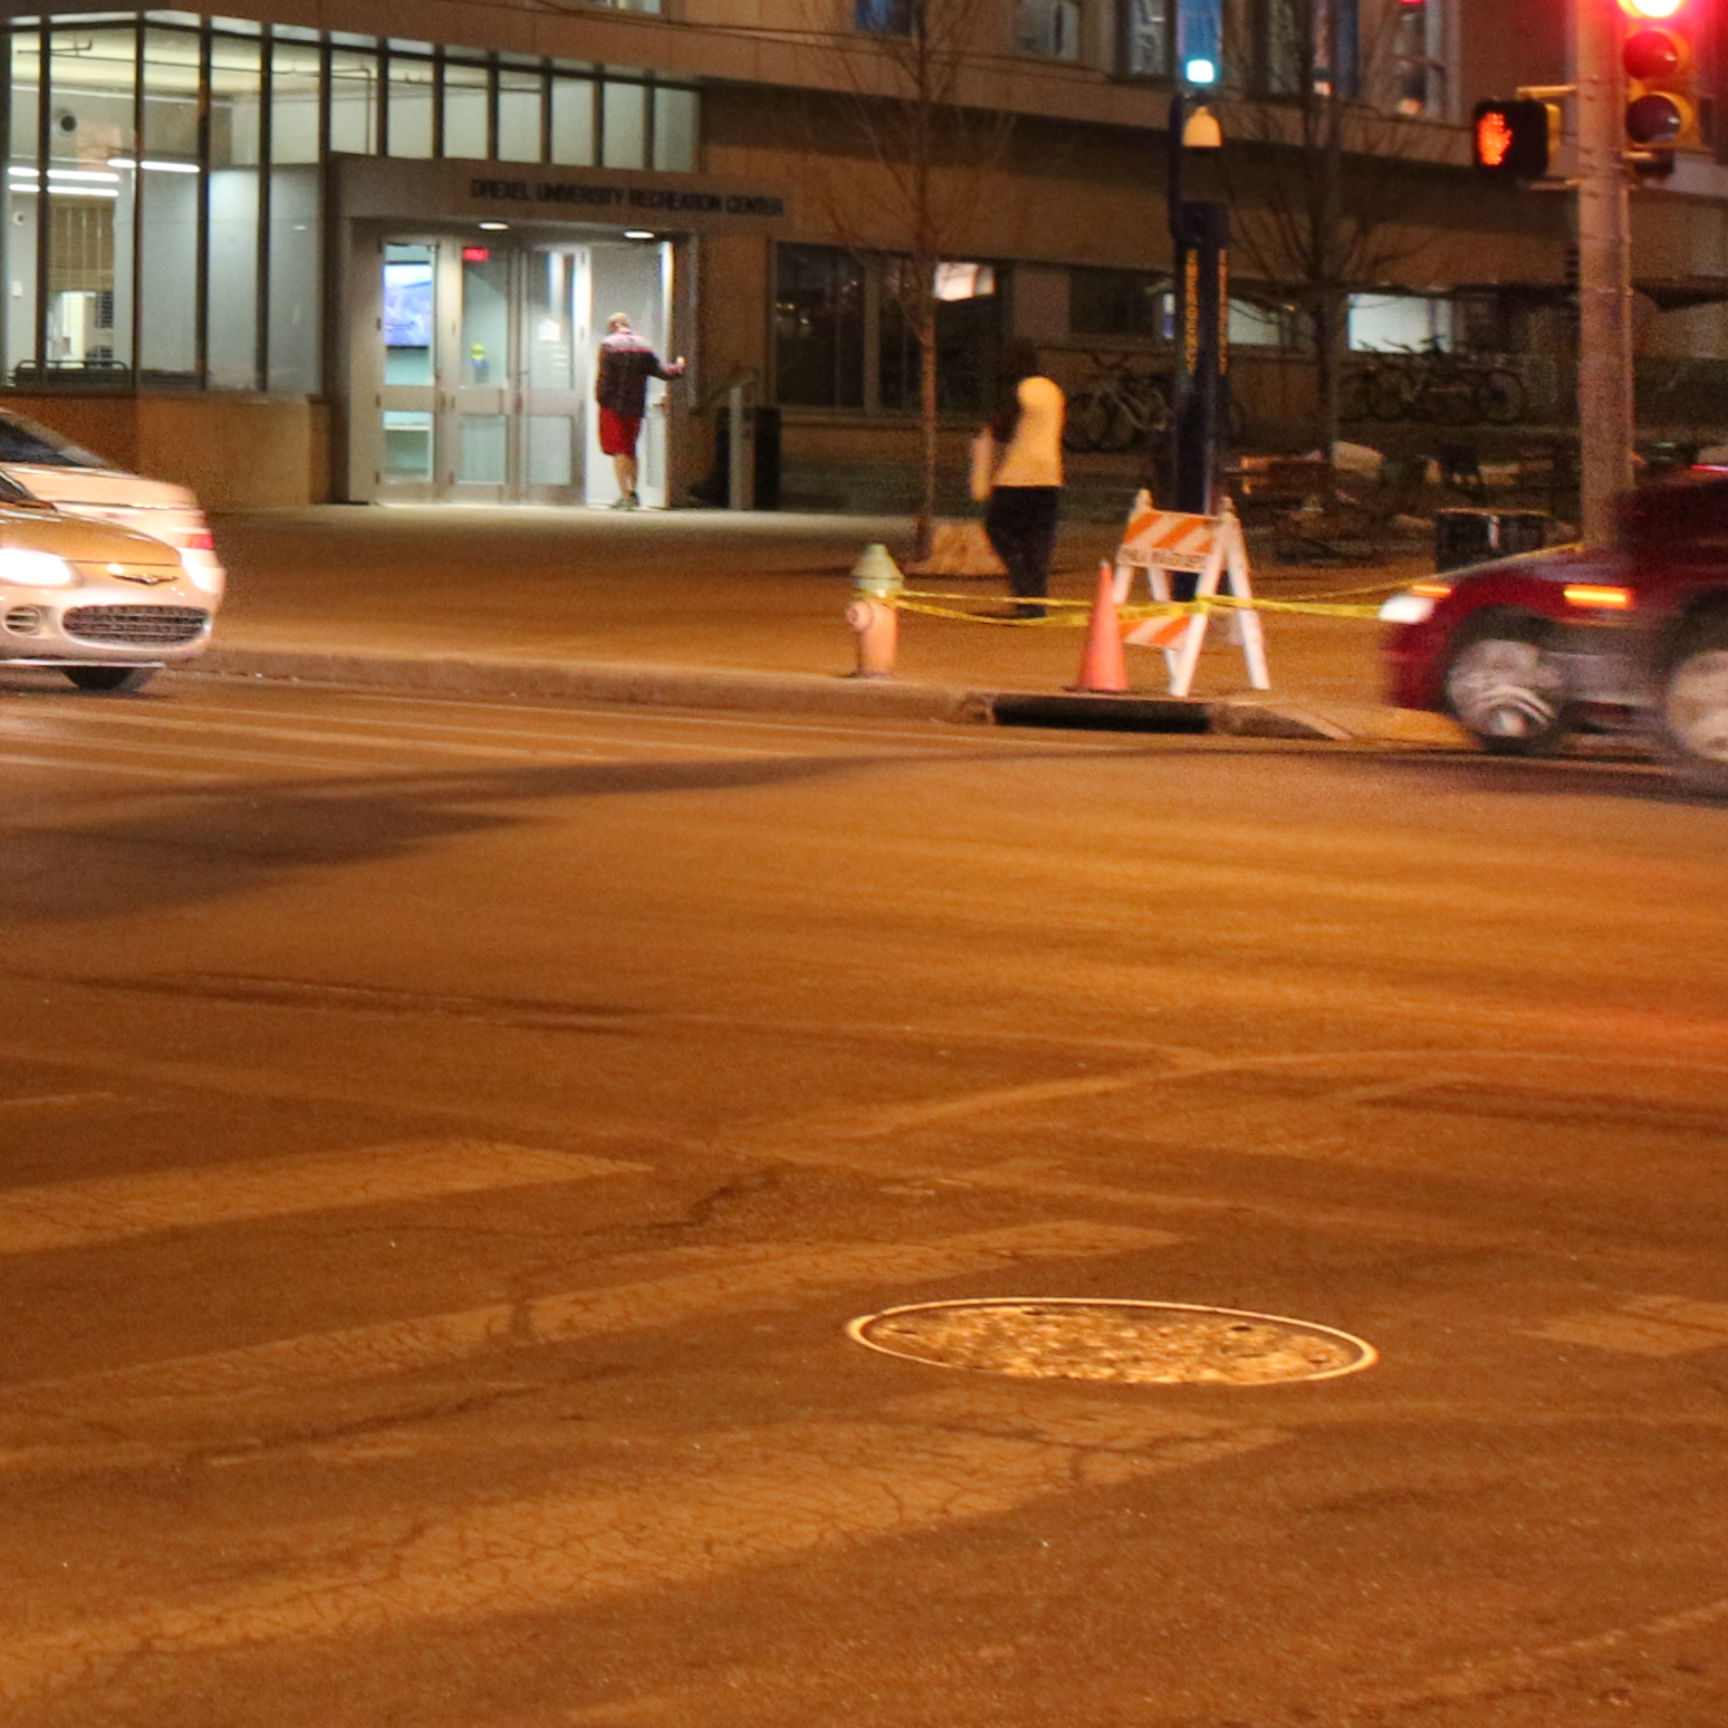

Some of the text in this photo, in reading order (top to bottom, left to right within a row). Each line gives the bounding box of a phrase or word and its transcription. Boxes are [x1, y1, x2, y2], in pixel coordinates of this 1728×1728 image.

[470, 179, 785, 217] DREXEL UNIVERSITY RECREATION CENTER
